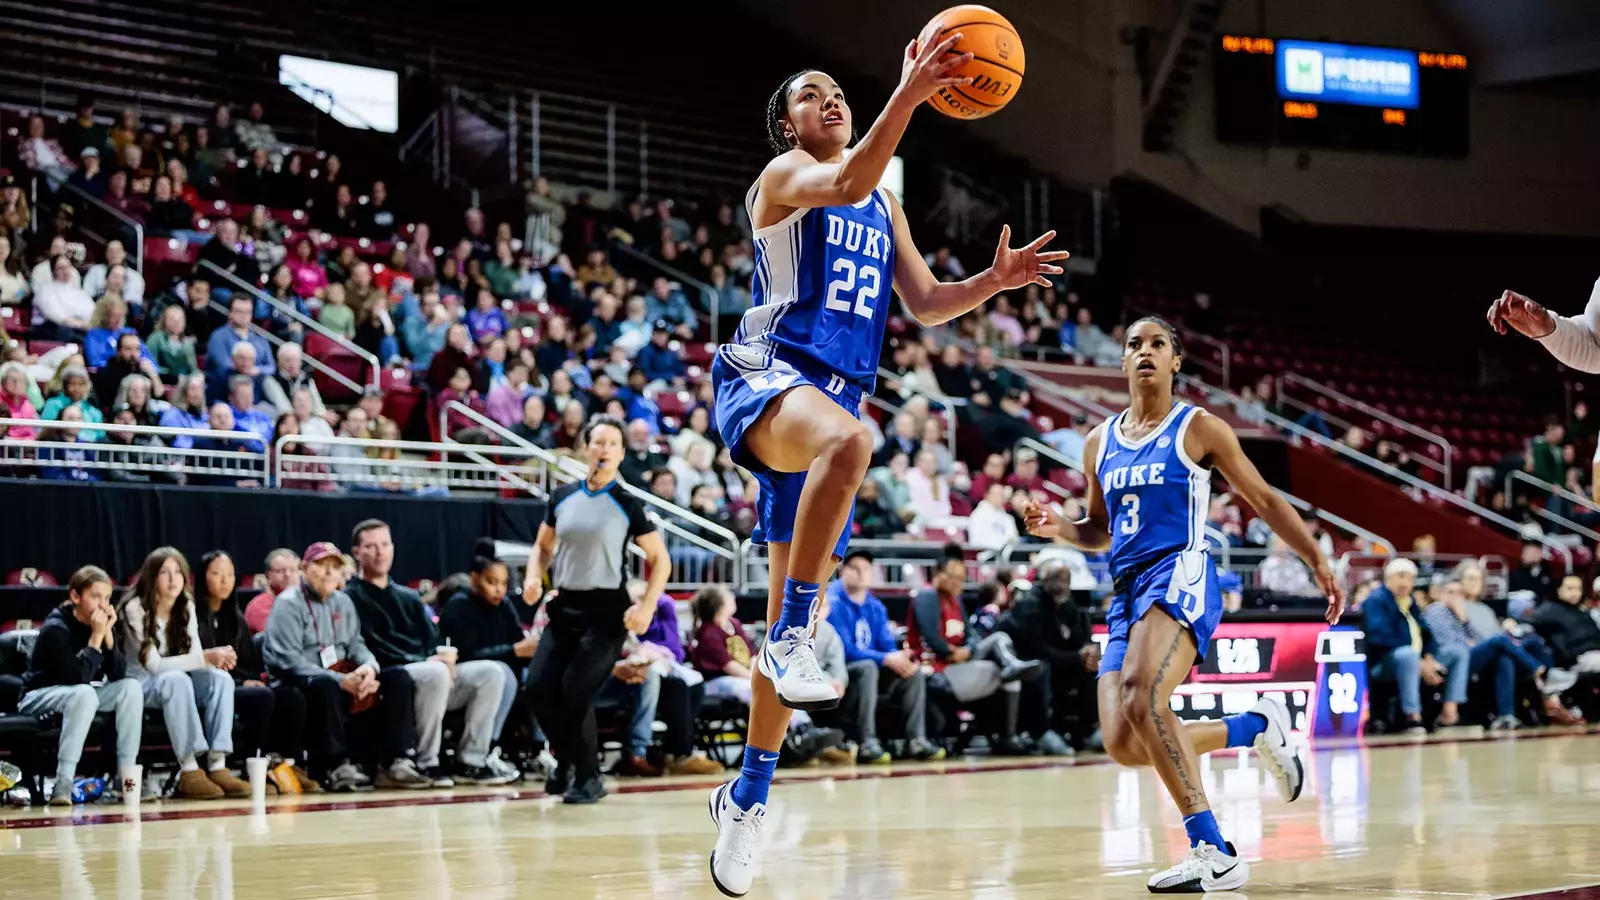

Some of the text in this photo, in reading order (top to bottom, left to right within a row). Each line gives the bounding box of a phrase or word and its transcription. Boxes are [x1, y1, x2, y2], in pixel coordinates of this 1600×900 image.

[826, 214, 891, 265] DUKE
[825, 257, 881, 320] 22
[824, 372, 846, 396] D
[1103, 462, 1166, 495] DUKE
[1121, 493, 1140, 535] 3
[1184, 792, 1206, 809] 222
